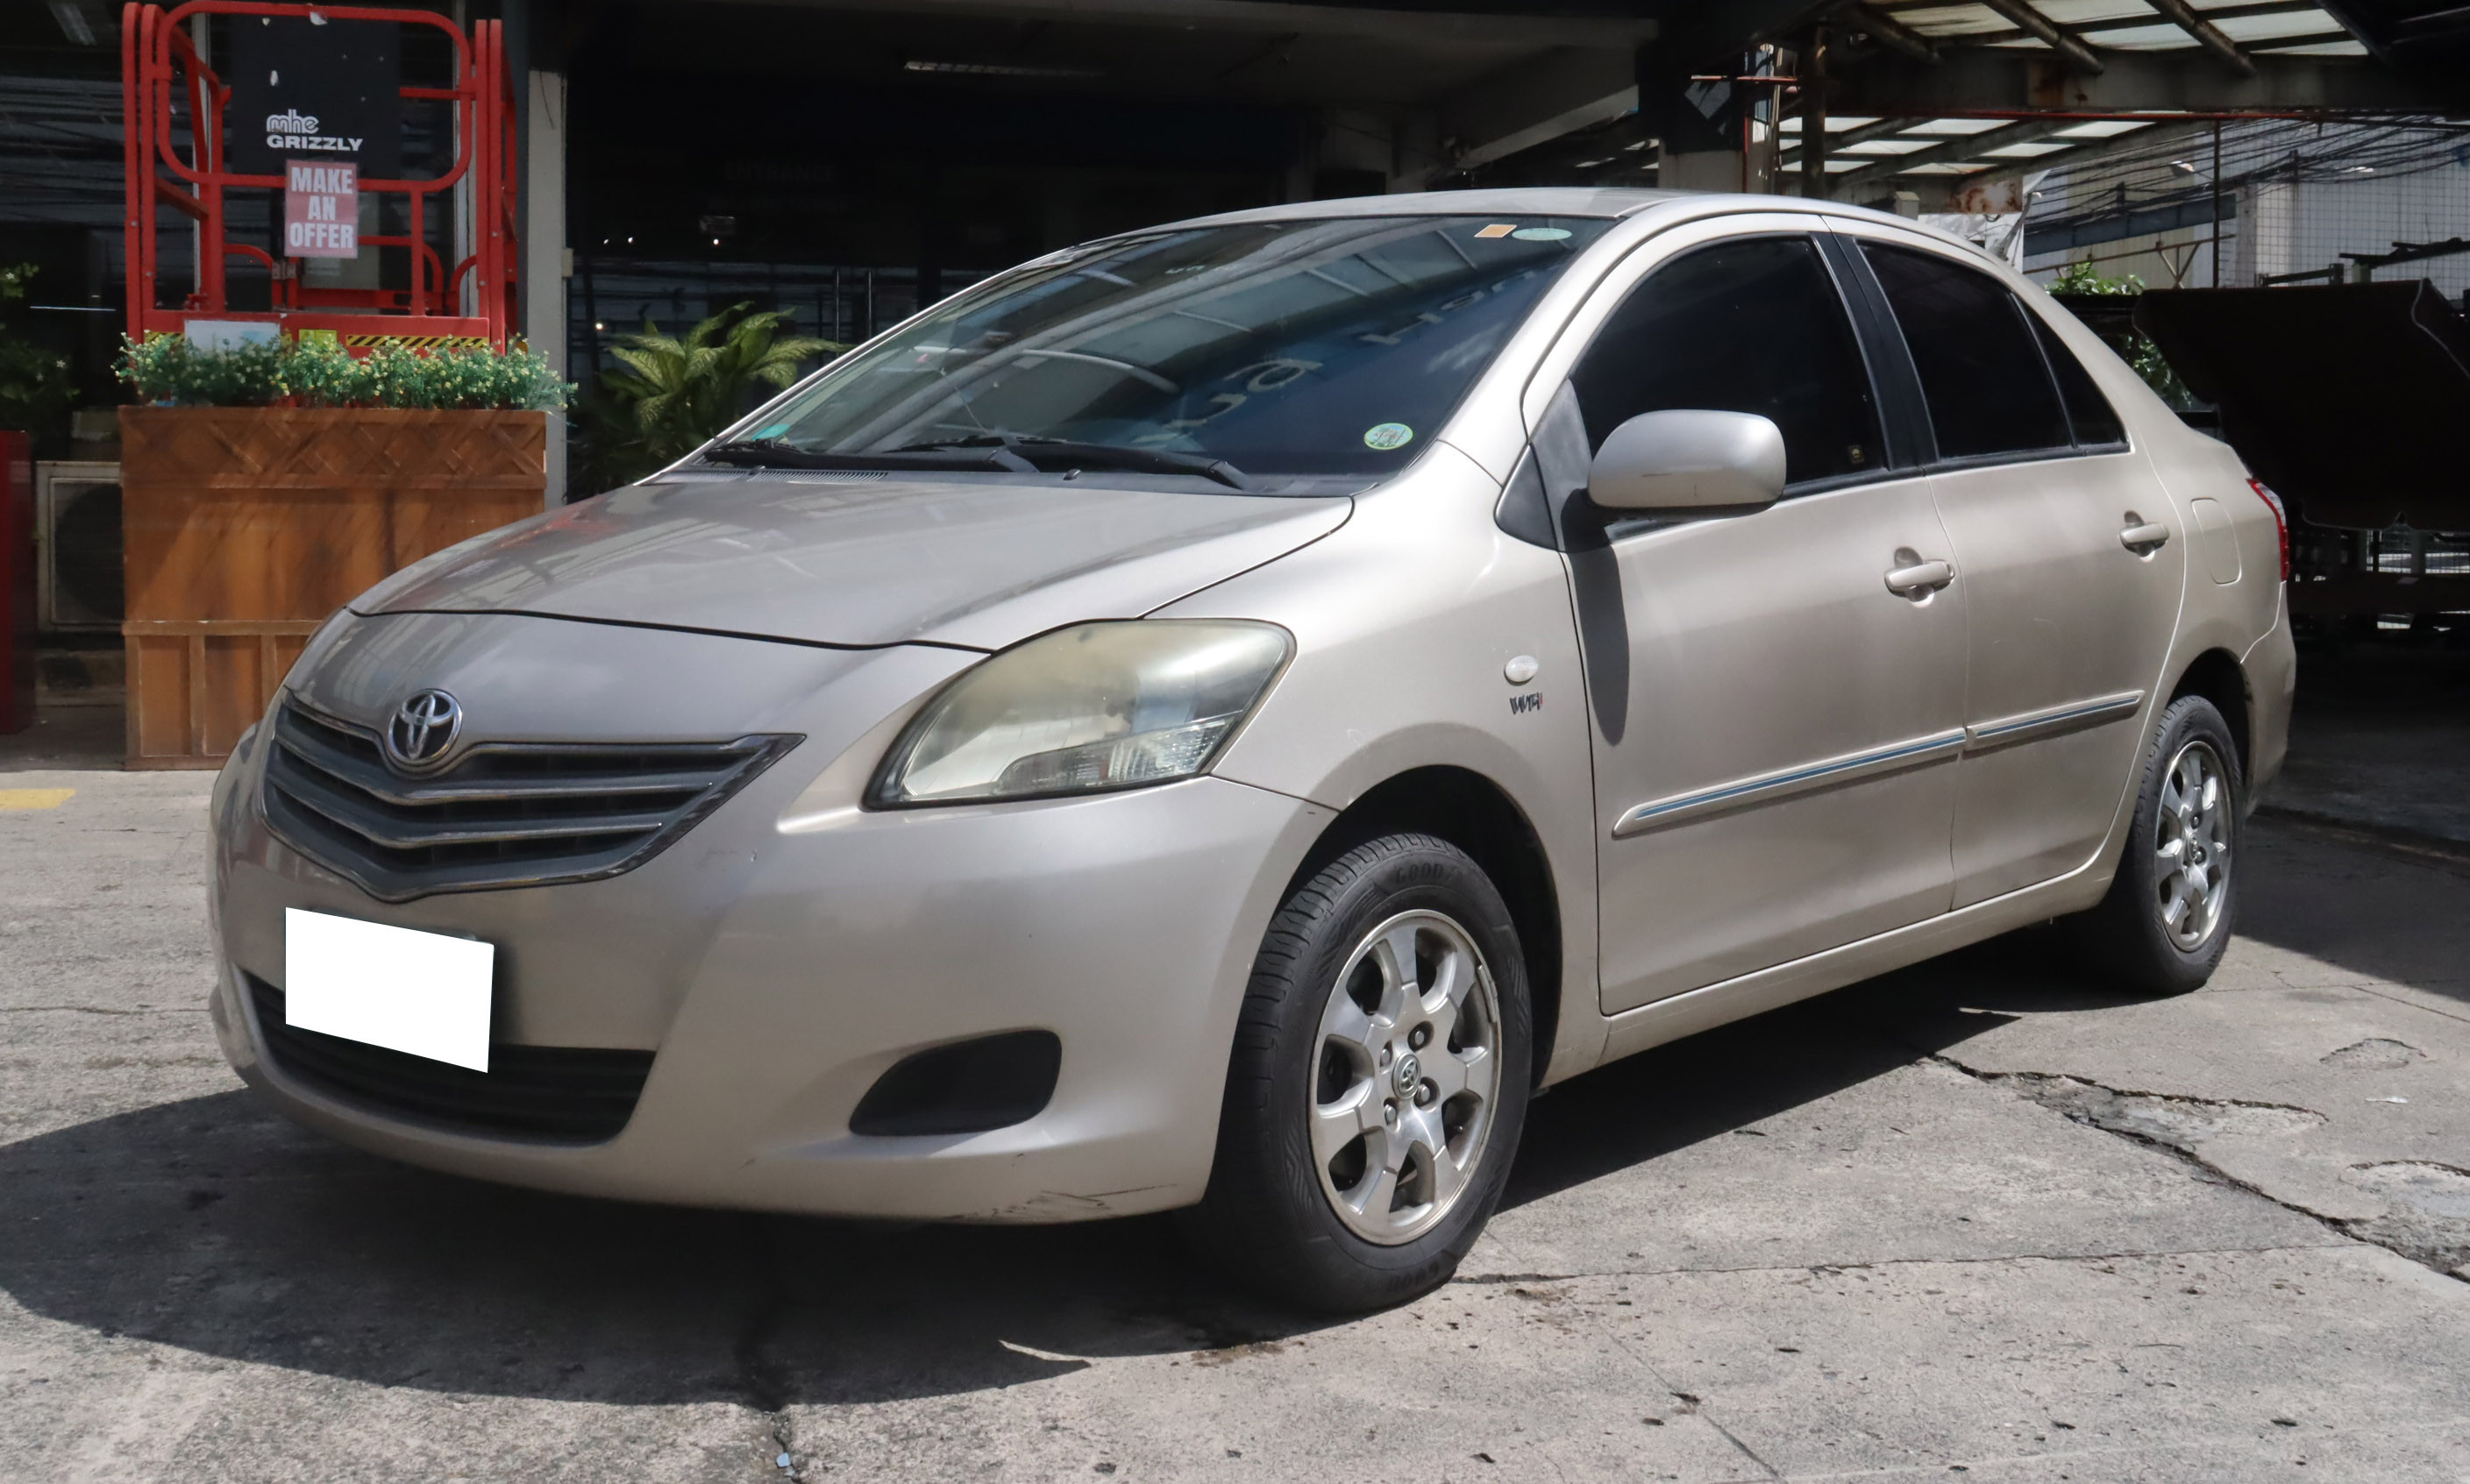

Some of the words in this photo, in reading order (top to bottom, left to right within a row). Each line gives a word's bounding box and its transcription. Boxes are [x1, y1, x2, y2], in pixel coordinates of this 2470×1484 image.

[267, 109, 319, 134] mhe
[267, 135, 363, 151] GRIZZLY
[291, 167, 352, 194] MAKE
[307, 195, 337, 221] AN
[289, 223, 353, 249] OFFER
